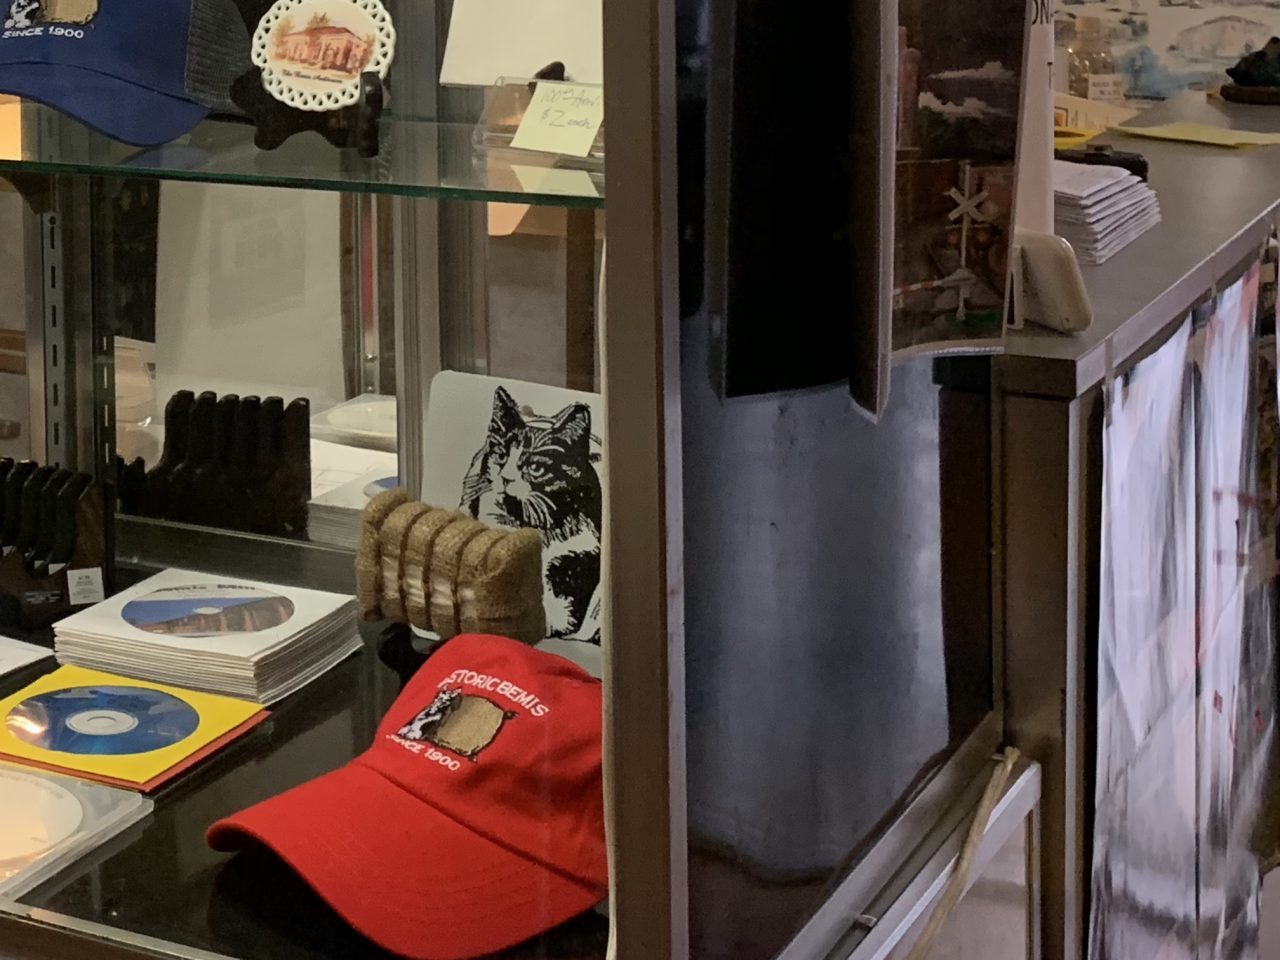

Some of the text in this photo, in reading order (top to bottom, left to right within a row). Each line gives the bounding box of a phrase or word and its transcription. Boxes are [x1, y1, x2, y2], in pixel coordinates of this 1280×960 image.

[2, 25, 84, 39] SINCE 1900
[496, 681, 550, 717] BEMIS
[424, 748, 461, 771] 1900
